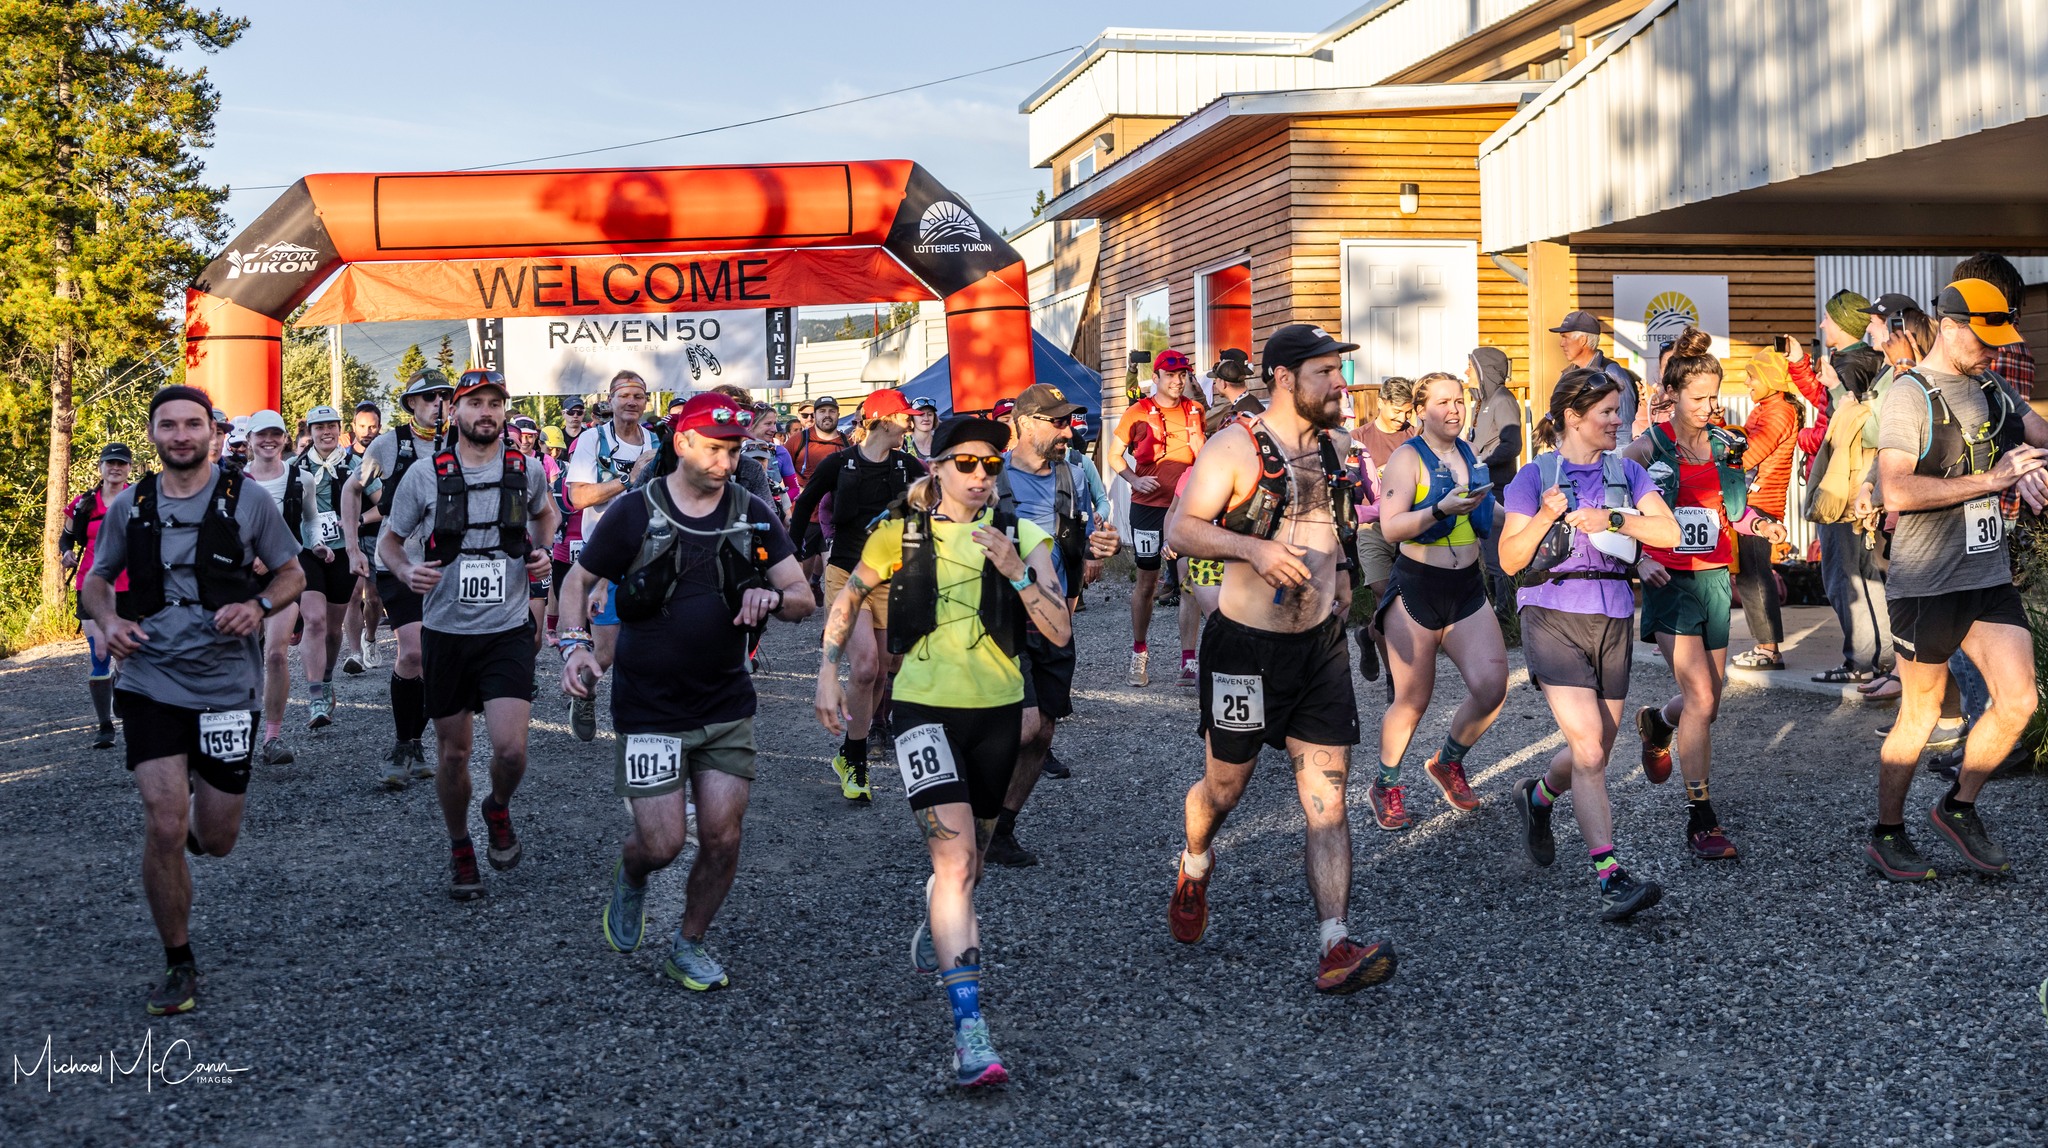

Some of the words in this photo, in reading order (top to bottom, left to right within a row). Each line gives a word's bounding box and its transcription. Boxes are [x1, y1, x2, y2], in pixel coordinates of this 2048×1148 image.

[269, 251, 319, 262] SPORT
[913, 244, 961, 254] LOTTERIES
[962, 243, 992, 253] YUKON
[226, 249, 319, 279] YUKON
[472, 258, 771, 310] WELCOME
[549, 315, 668, 349] RAVEN
[676, 318, 721, 341] 50
[773, 311, 785, 375] FINISH
[1637, 333, 1679, 343] LOTTERIES
[484, 317, 497, 372] FINIS
[1684, 523, 1708, 546] 36
[1977, 515, 1997, 543] 30
[1140, 540, 1151, 553] 11
[465, 562, 491, 570] RAVEN
[461, 575, 503, 599] 109-1
[1215, 676, 1243, 686] RAVEN
[1243, 678, 1256, 686] 50
[206, 713, 235, 723] RAVEN
[1223, 694, 1250, 722] 25
[202, 727, 249, 756] 159-1
[632, 737, 662, 745] RAVEN
[900, 728, 925, 748] RAVEN
[627, 753, 677, 780] 101-1
[908, 745, 941, 780] 58
